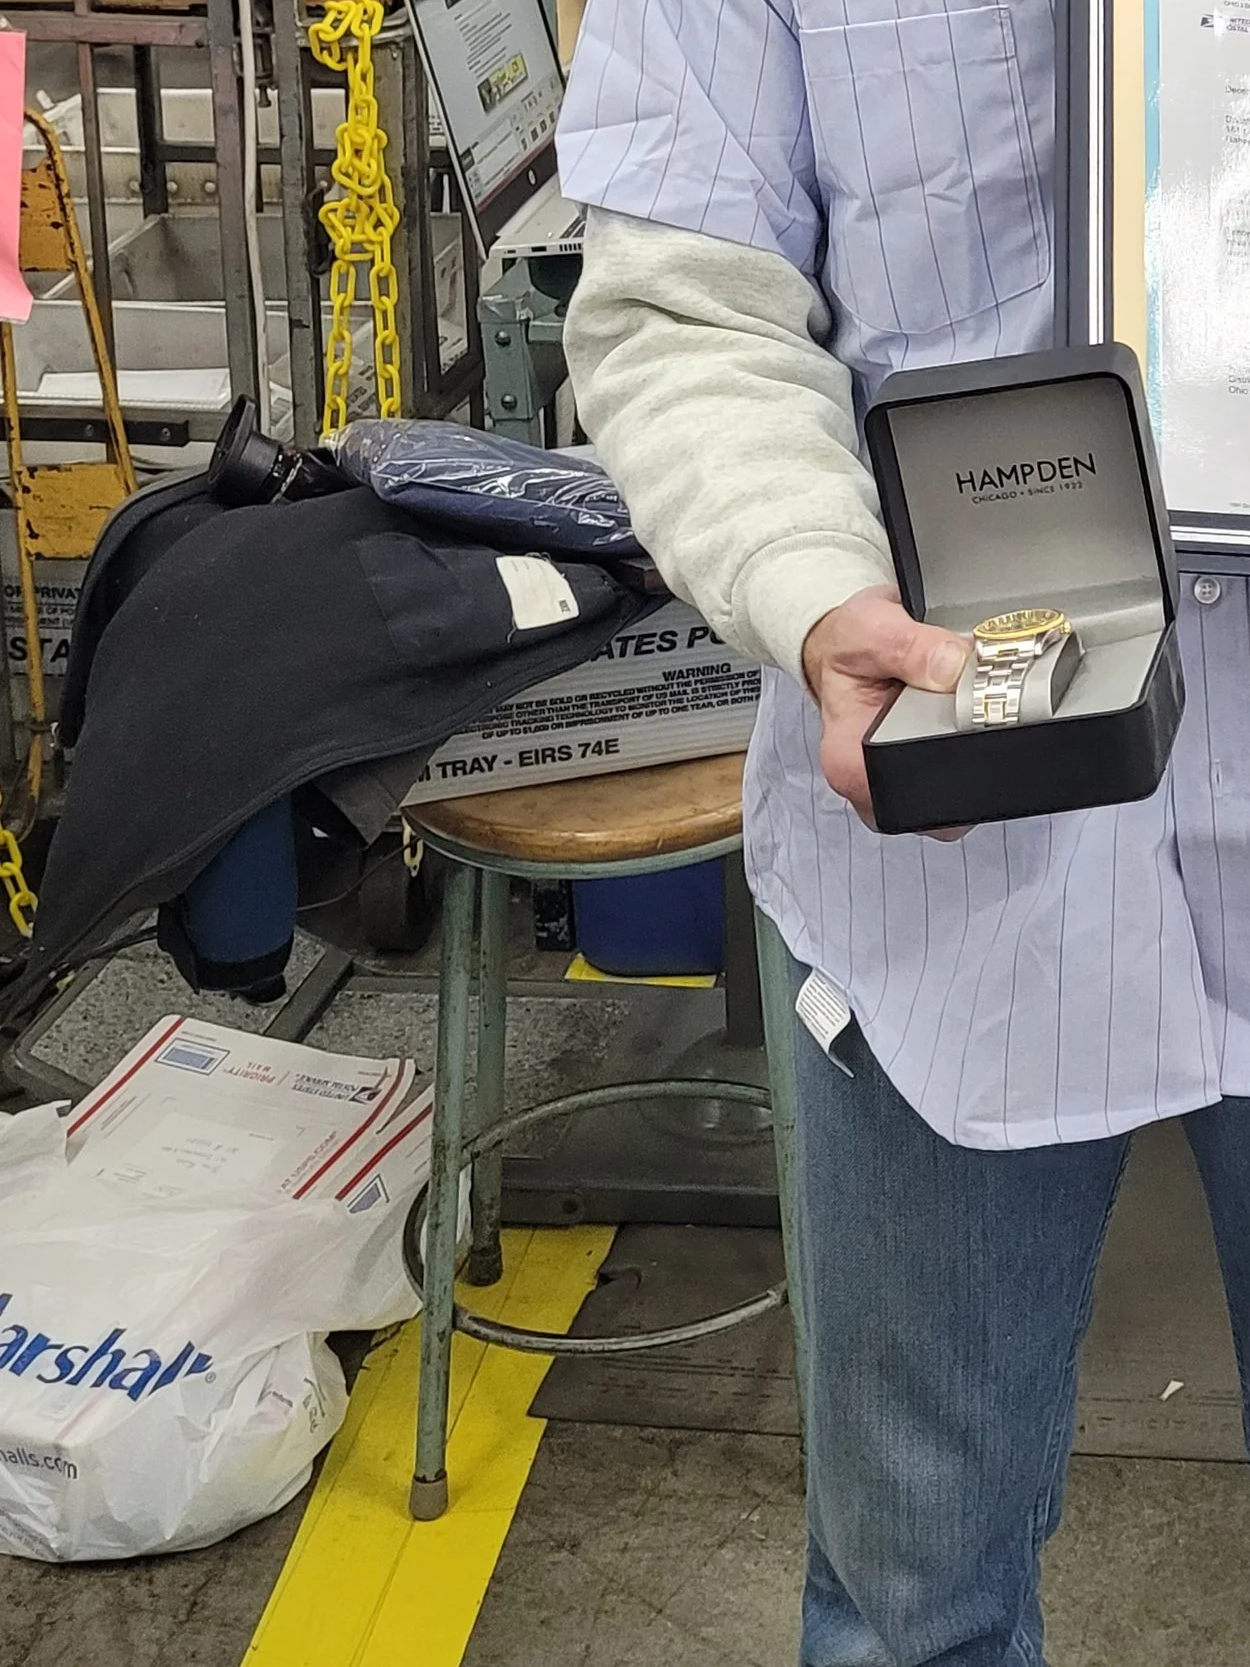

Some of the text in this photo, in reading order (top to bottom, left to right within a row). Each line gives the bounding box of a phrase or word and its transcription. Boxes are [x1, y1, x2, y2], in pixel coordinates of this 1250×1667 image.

[956, 453, 1096, 494] HAMPDEN
[972, 481, 1083, 504] CHICAGO SINCE 1922
[662, 662, 731, 682] WARNING
[549, 696, 573, 706] SOLD
[637, 683, 674, 694] WITHOUT
[516, 695, 641, 718] OTHER TRANSPORT
[436, 754, 498, 779] TRAY
[518, 744, 573, 768] EIRS
[577, 738, 620, 759] 74E
[226, 1066, 276, 1084] PRIORITY
